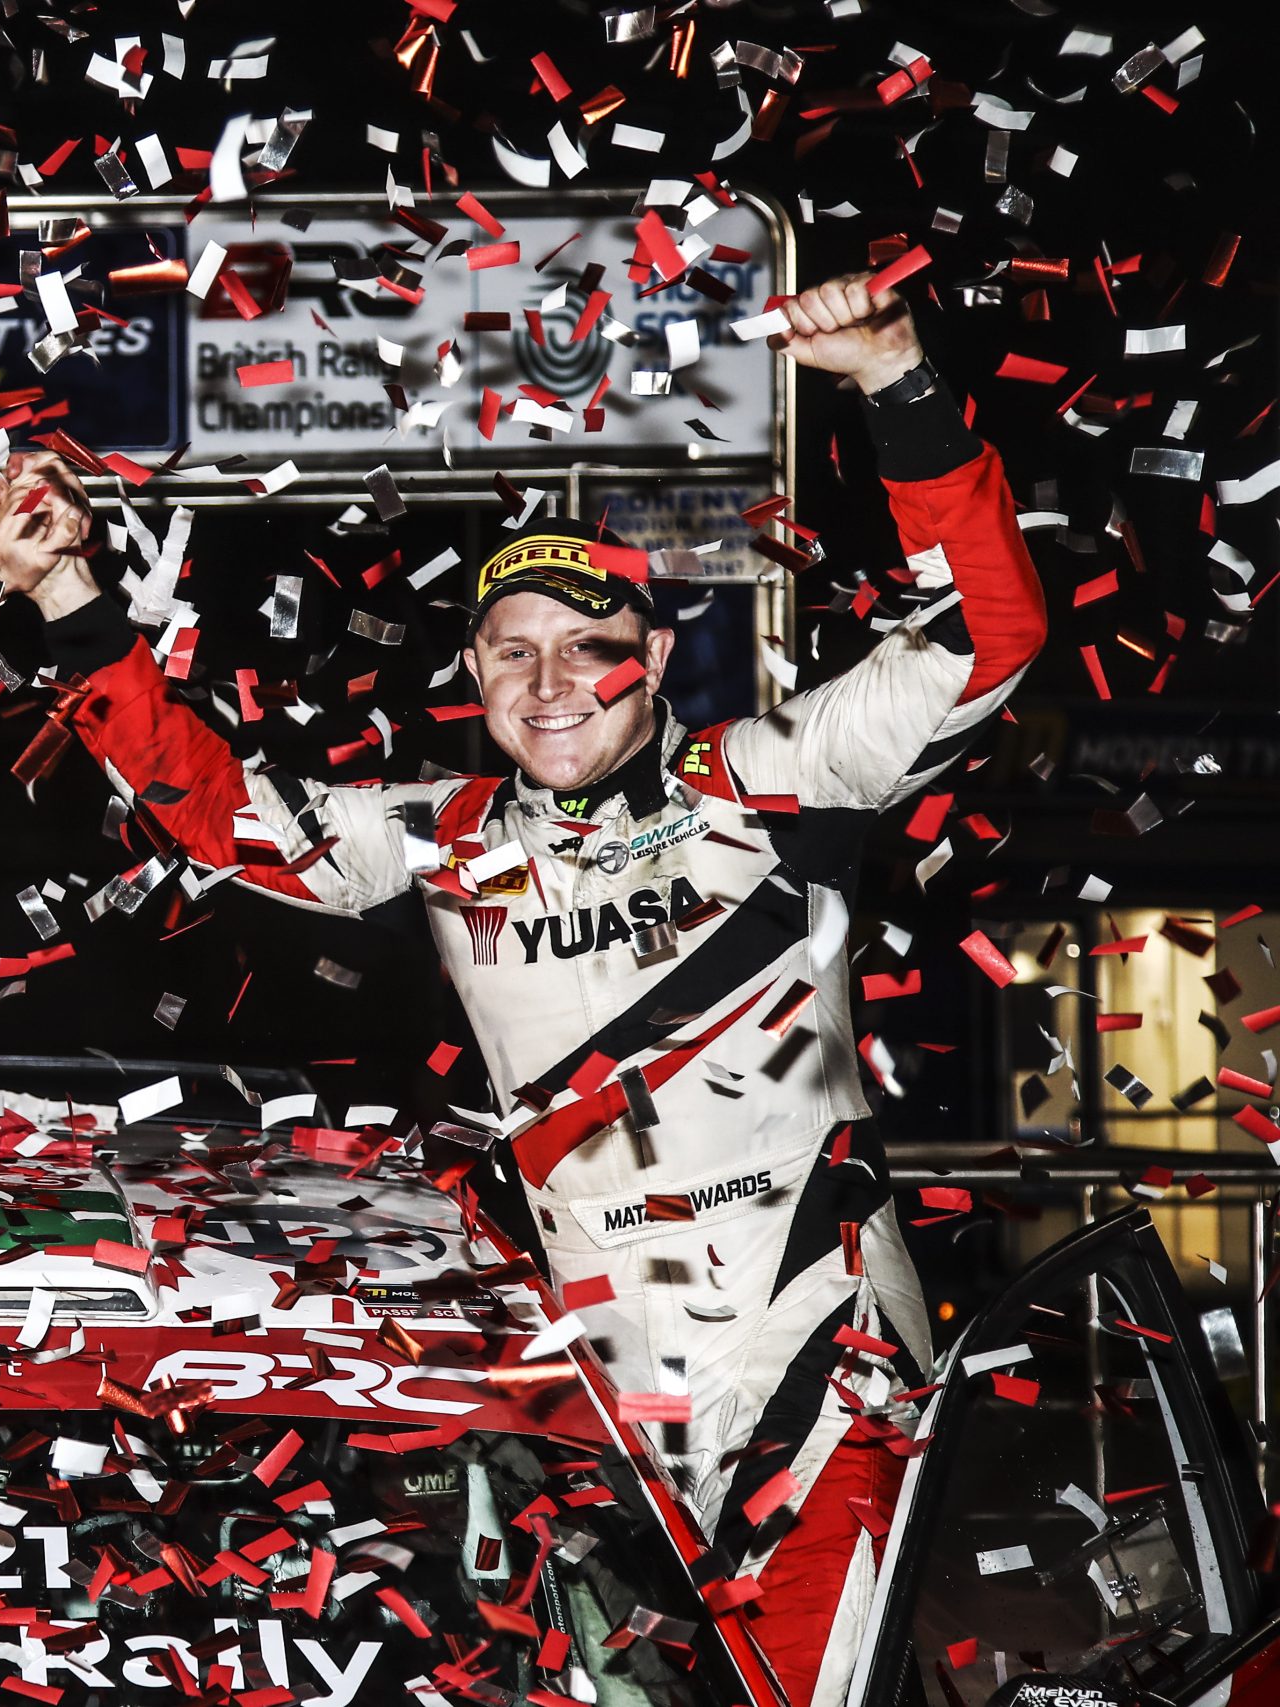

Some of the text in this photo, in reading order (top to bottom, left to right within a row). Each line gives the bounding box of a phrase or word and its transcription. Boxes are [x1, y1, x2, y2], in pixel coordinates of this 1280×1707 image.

[197, 389, 429, 438] Champions
[484, 539, 597, 585] PIRELL
[630, 812, 700, 851] SWIFT
[631, 821, 711, 861] LEISURE VEHICLES
[511, 876, 708, 964] YUASA
[604, 1170, 772, 1232] MAT WARDS
[372, 1308, 424, 1317] PASSE
[144, 1349, 490, 1416] BRC
[1024, 1686, 1103, 1699] Melvyn
[1053, 1696, 1119, 1707] Evans
